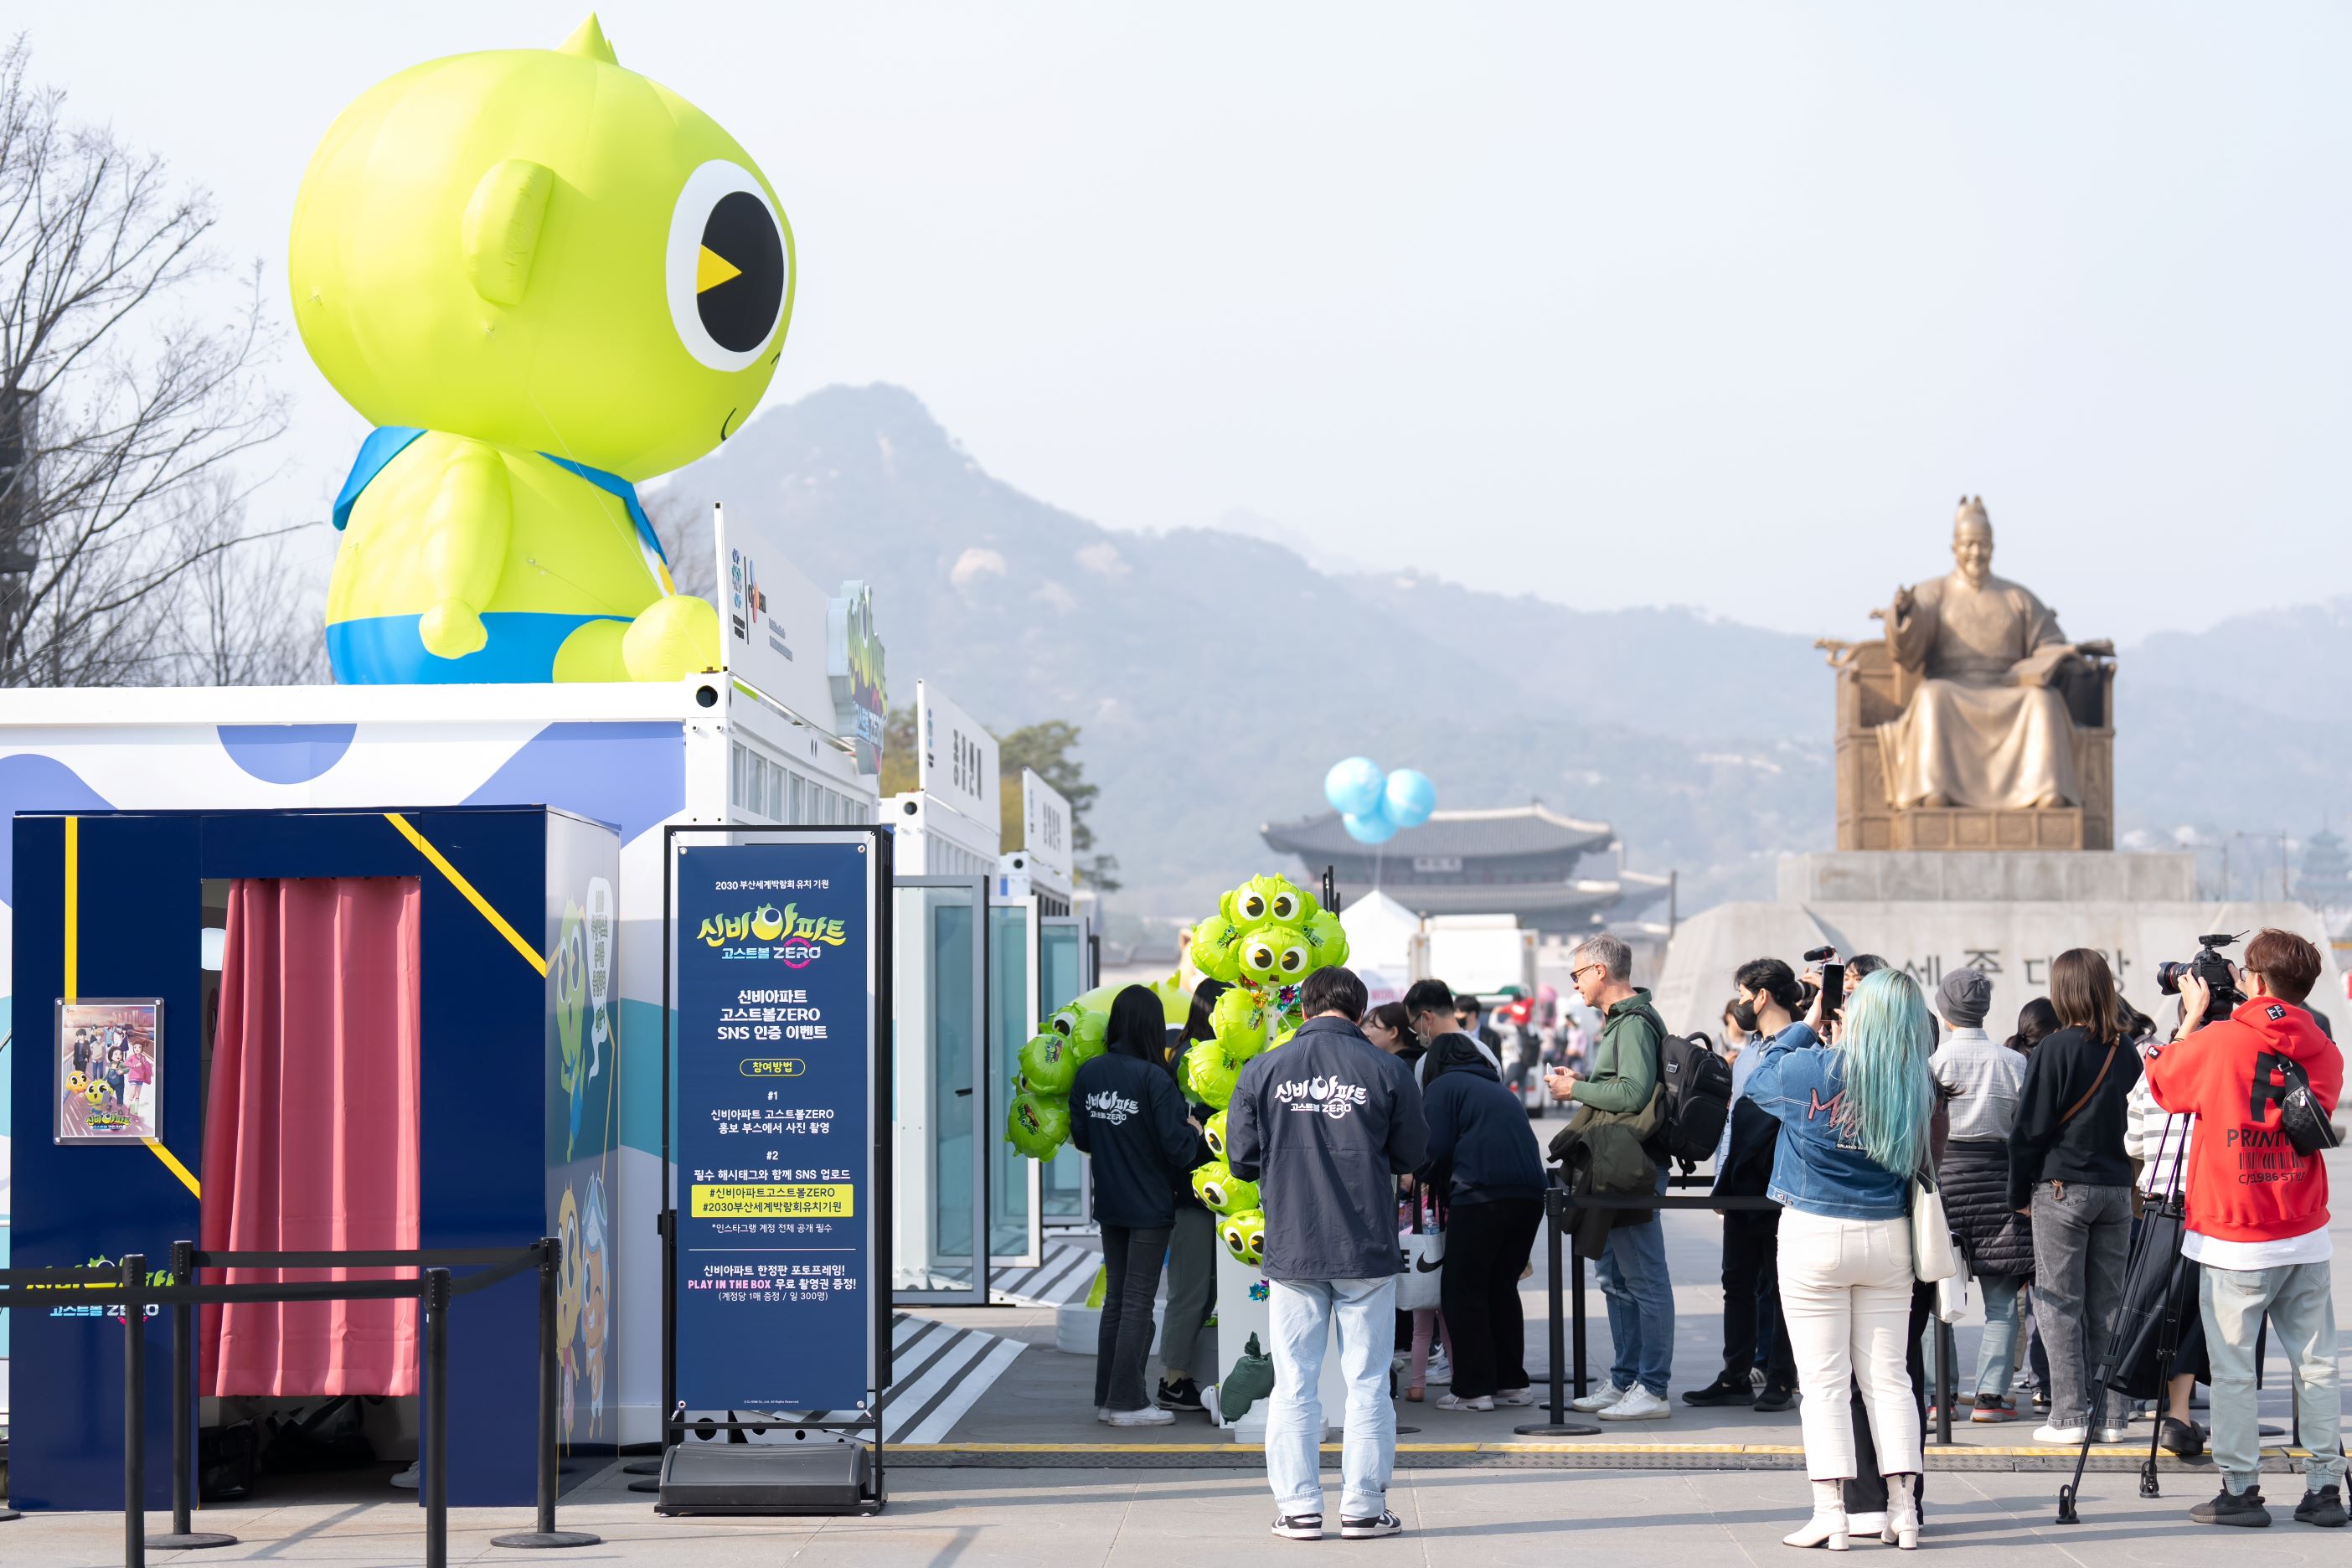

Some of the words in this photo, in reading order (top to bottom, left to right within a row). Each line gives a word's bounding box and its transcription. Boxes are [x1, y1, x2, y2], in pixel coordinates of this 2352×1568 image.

[716, 881, 738, 890] 2030
[740, 879, 794, 890] 부산세계박람회
[796, 879, 811, 889] 유치
[813, 879, 828, 889] 기원
[696, 902, 847, 947] 신비아파트
[721, 947, 770, 960] 고스트볼
[773, 946, 822, 959] ZERO
[738, 990, 807, 1004] 신비아파트
[720, 1008, 820, 1022] 고스트볼ZERO
[718, 1027, 750, 1039] SNS
[754, 1026, 781, 1039] 인증
[787, 1025, 828, 1039] 이벤트
[753, 1062, 792, 1073] 참여방법
[768, 1091, 777, 1100] #1
[1274, 1075, 1367, 1106] 신비아파트
[1322, 1103, 1352, 1112] ZERO
[711, 1109, 761, 1121] 신비아파트
[765, 1109, 833, 1120] 고스트볼ZERO
[719, 1122, 739, 1134] 홍보
[742, 1122, 781, 1133] 부스에서
[786, 1122, 805, 1133] 사진
[809, 1122, 829, 1133] 촬영
[766, 1151, 778, 1160] #2
[694, 1169, 714, 1181] 필수
[718, 1169, 768, 1181] 해시태그와
[772, 1169, 792, 1180] 함께
[796, 1170, 817, 1179] SNS
[821, 1169, 850, 1180] 업로드
[710, 1188, 835, 1199] #신비아파트고스트볼ZERO
[704, 1201, 841, 1213] #2030부산세계박람회유치기원
[760, 1224, 775, 1233] 계정
[779, 1224, 794, 1233] 전체
[797, 1224, 812, 1233] 공개
[816, 1224, 833, 1233] 필수
[704, 1266, 754, 1277] 신비아파트
[757, 1265, 788, 1277] 한정판
[791, 1265, 844, 1276] 포토프레임!
[689, 1280, 713, 1289] PLAY
[716, 1280, 725, 1288] IN
[730, 1280, 748, 1288] THE
[751, 1280, 771, 1289] BOX
[775, 1279, 796, 1290] 무료
[799, 1278, 828, 1290] 촬영권
[833, 1278, 856, 1290] 증정!
[719, 1292, 746, 1301] (계정당
[750, 1292, 761, 1301] 1매
[764, 1292, 779, 1301] 증정
[790, 1292, 797, 1301] 일
[801, 1292, 828, 1301] 300명)
[49, 1305, 103, 1317] 고스트볼
[106, 1303, 159, 1317] ZEO
